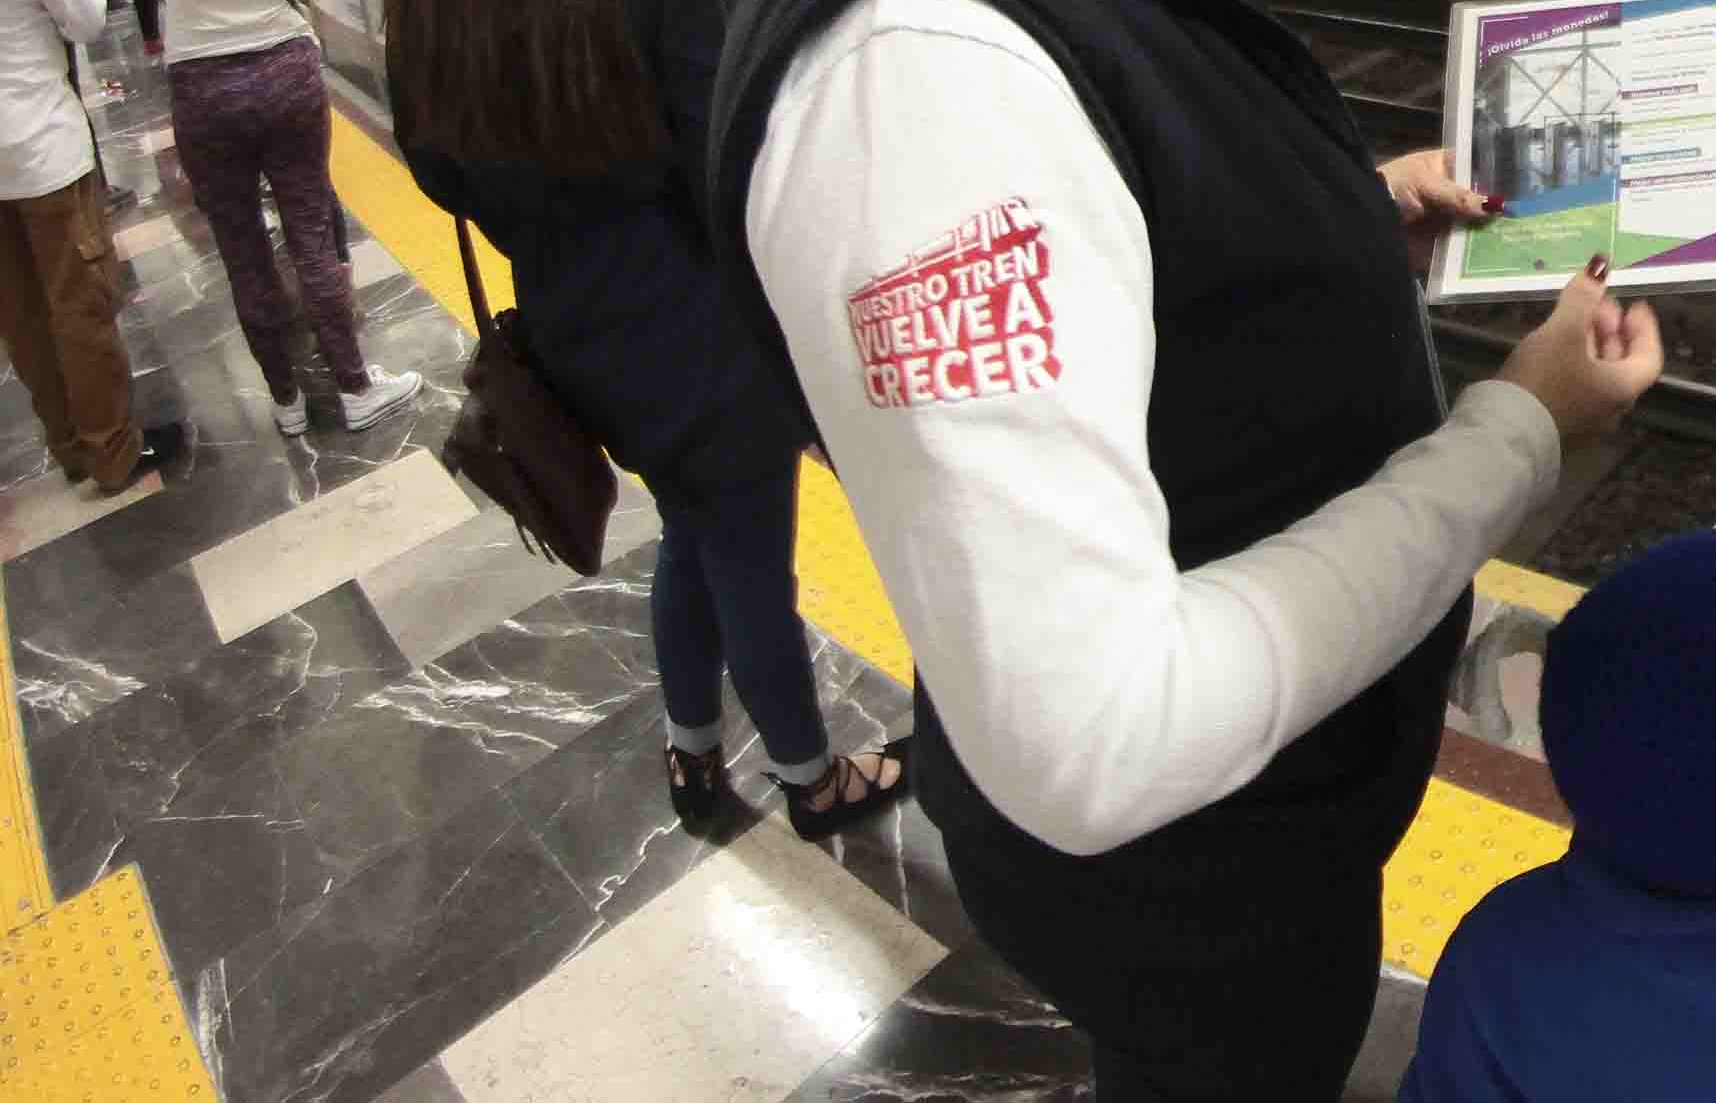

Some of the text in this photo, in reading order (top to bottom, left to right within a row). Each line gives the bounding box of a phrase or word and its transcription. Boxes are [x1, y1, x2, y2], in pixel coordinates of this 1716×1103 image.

[1530, 30, 1550, 42] las
[848, 241, 1038, 330] NUESTRO TREN
[855, 280, 1045, 363] VUELVE A
[864, 333, 1060, 410] CRECER
